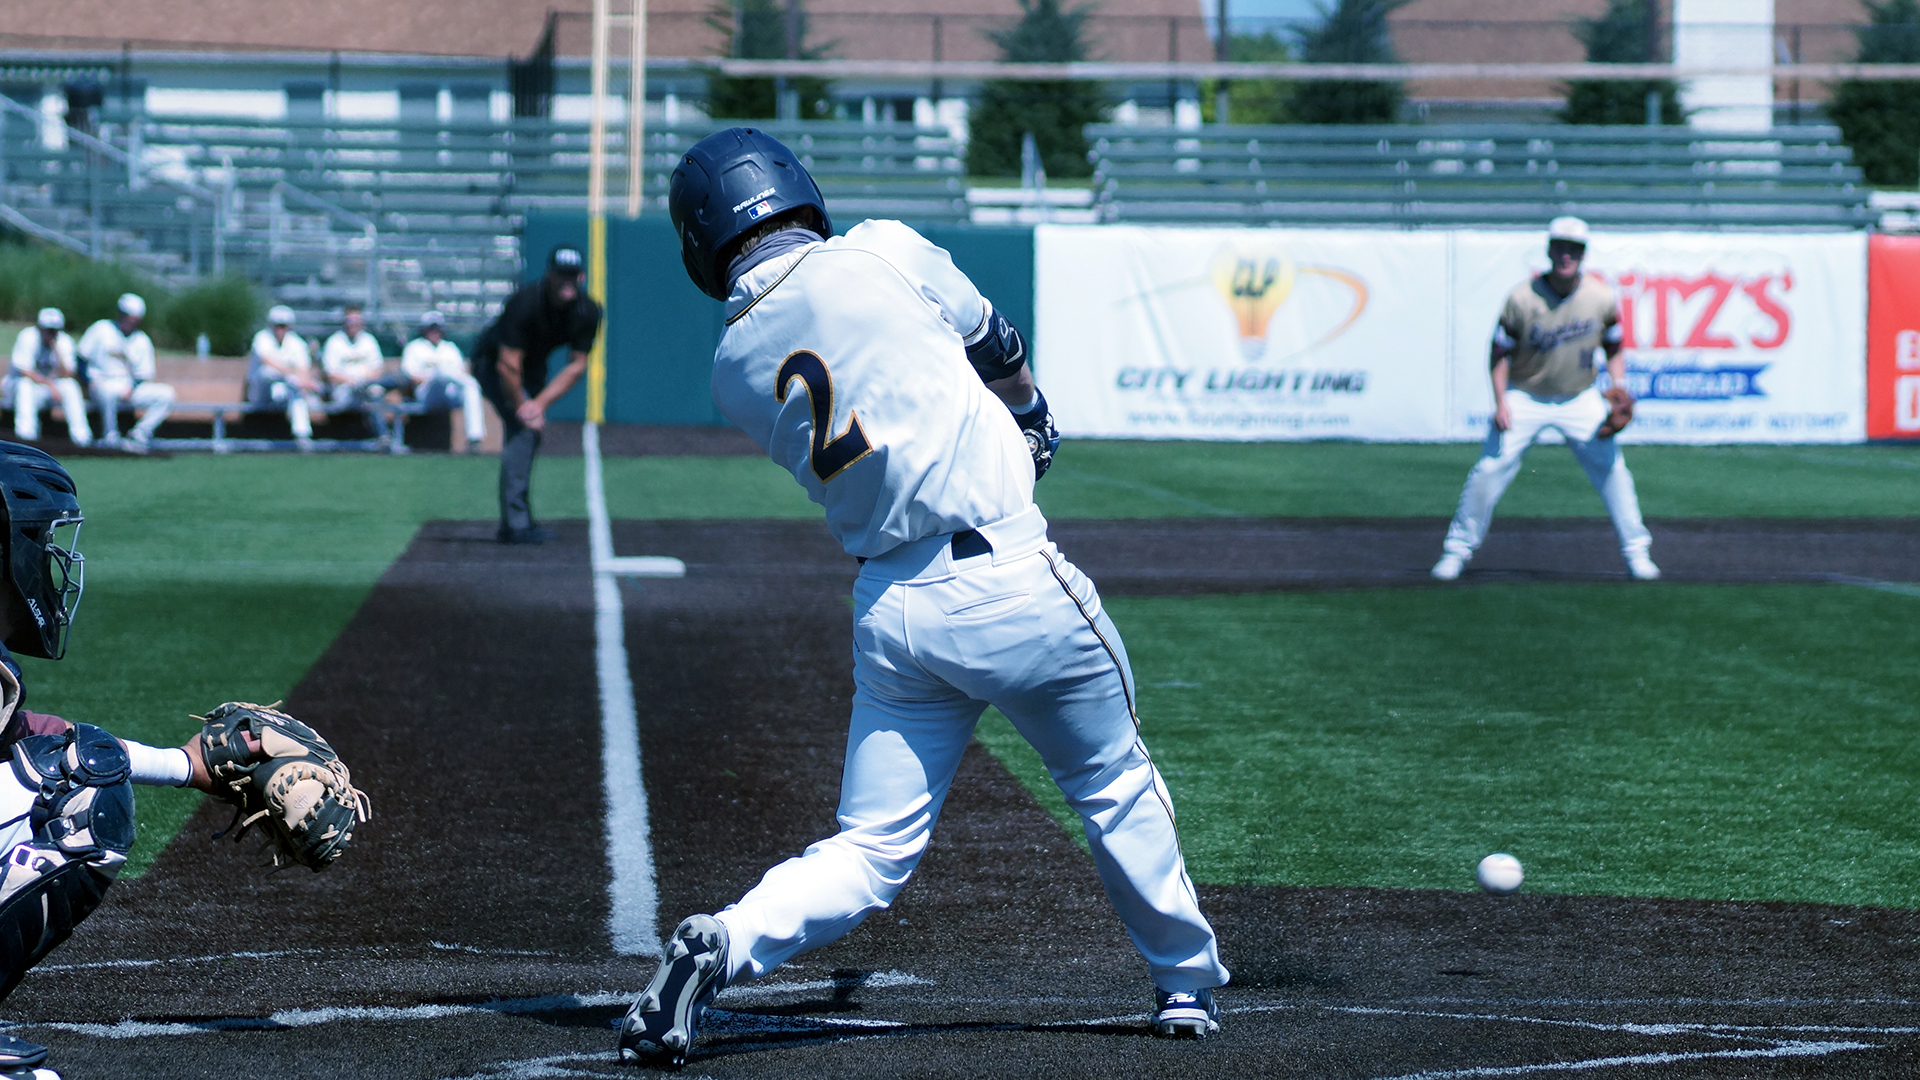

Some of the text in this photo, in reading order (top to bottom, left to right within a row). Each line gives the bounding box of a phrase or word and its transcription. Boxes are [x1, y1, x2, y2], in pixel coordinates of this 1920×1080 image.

[732, 187, 776, 213] RAWLINGS
[1117, 368, 1367, 393] CITY LIGHTING
[775, 349, 874, 484] 2
